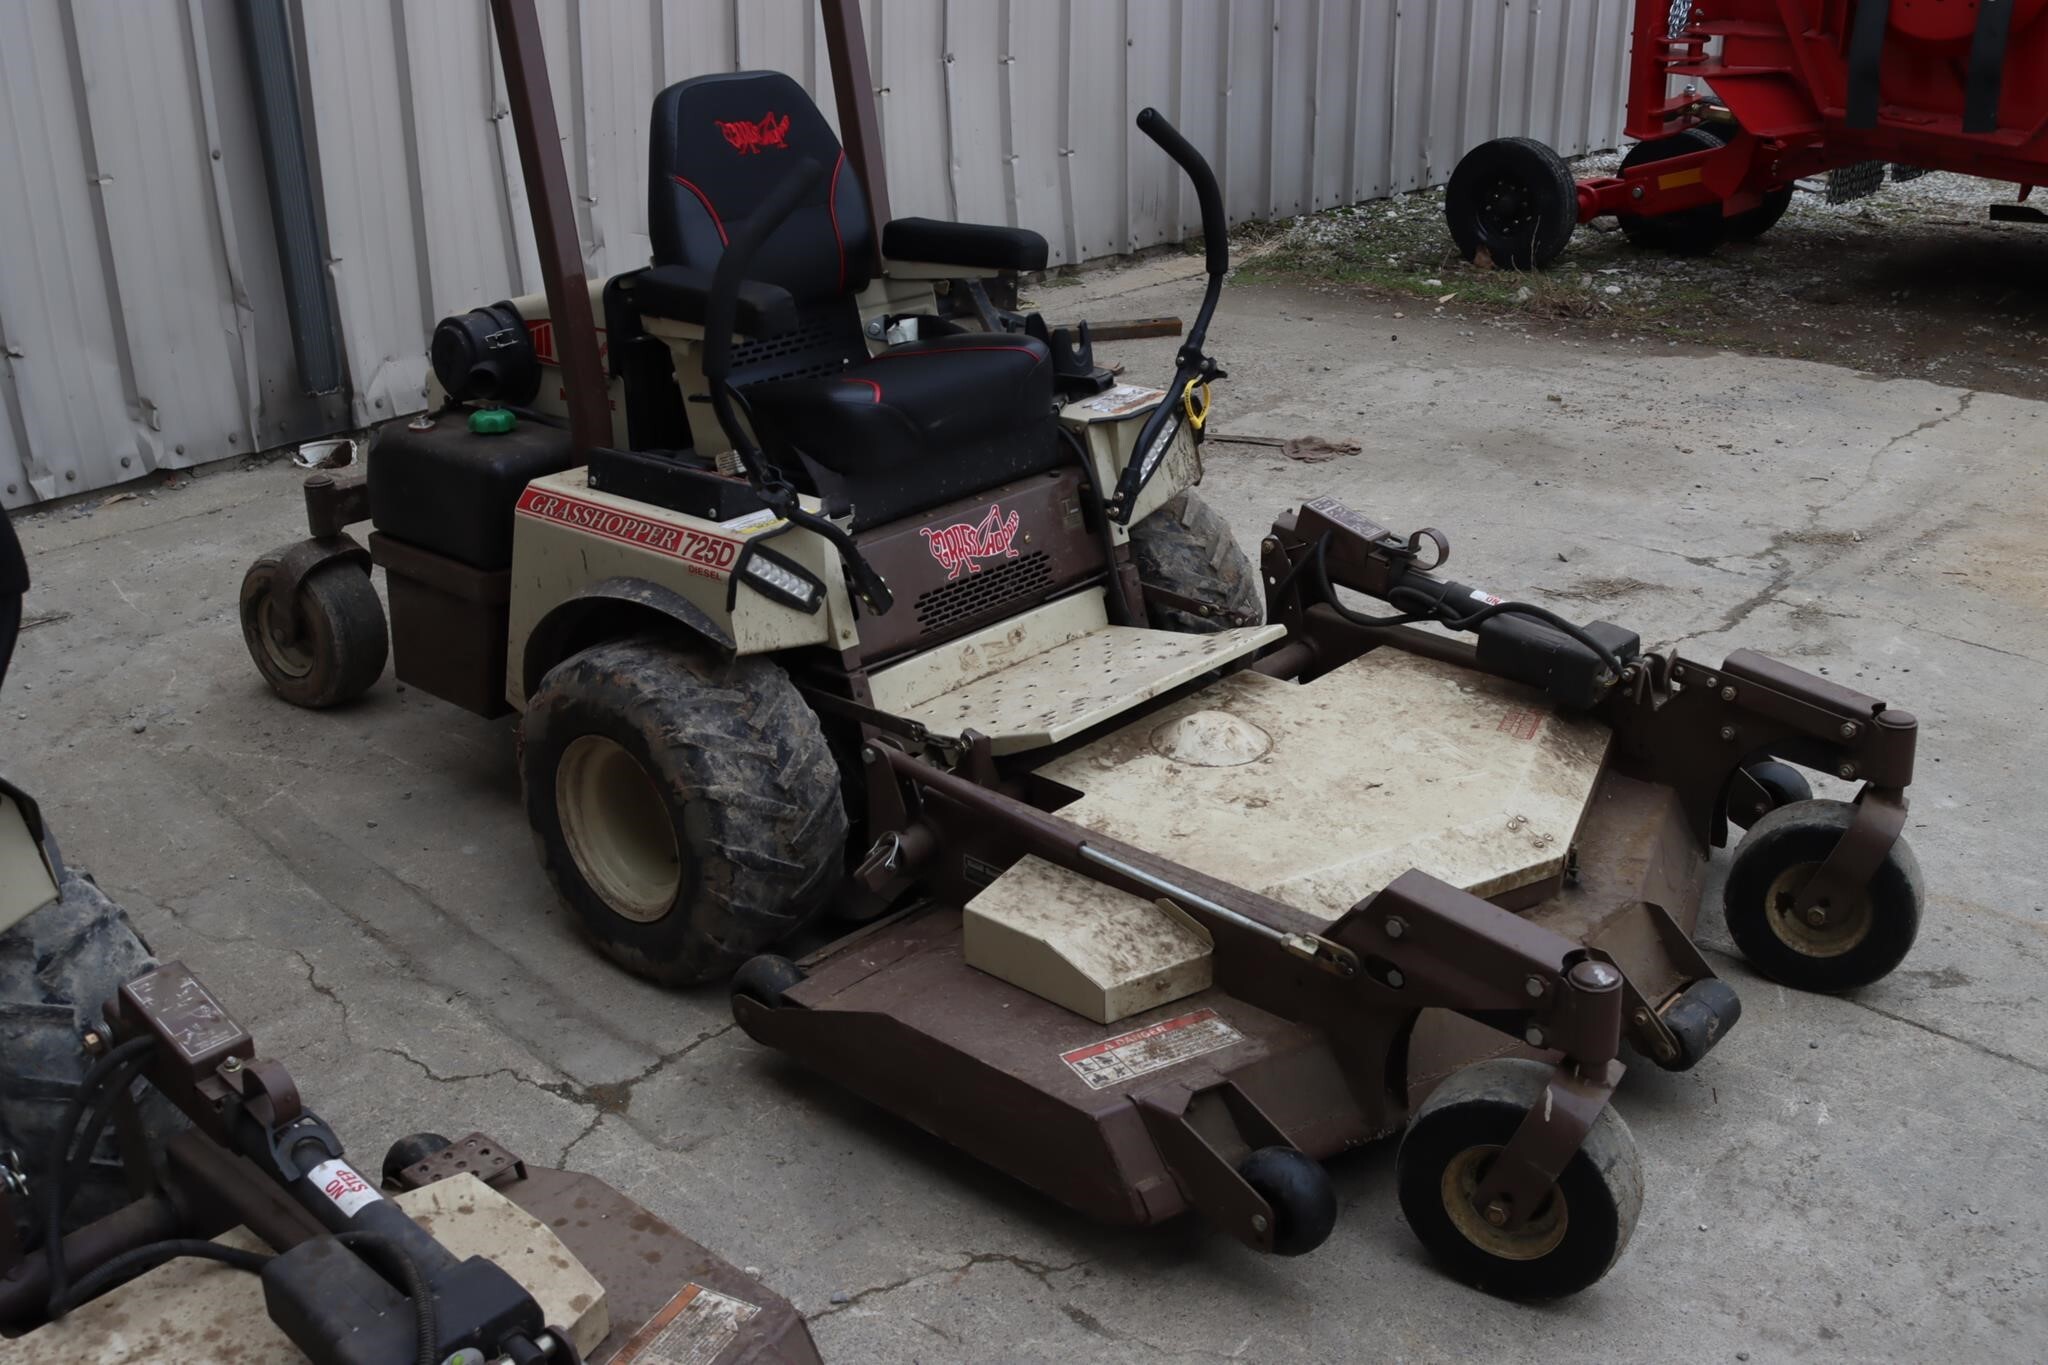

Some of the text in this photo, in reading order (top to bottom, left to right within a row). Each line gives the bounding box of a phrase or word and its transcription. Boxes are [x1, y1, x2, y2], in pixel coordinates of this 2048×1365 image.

[529, 494, 678, 550] GRASSHOPPER
[682, 532, 736, 567] 725D
[687, 564, 722, 581] DIESEL
[1116, 1026, 1168, 1048] DANGER
[325, 1179, 351, 1200] NO
[336, 1169, 368, 1192] STEP
